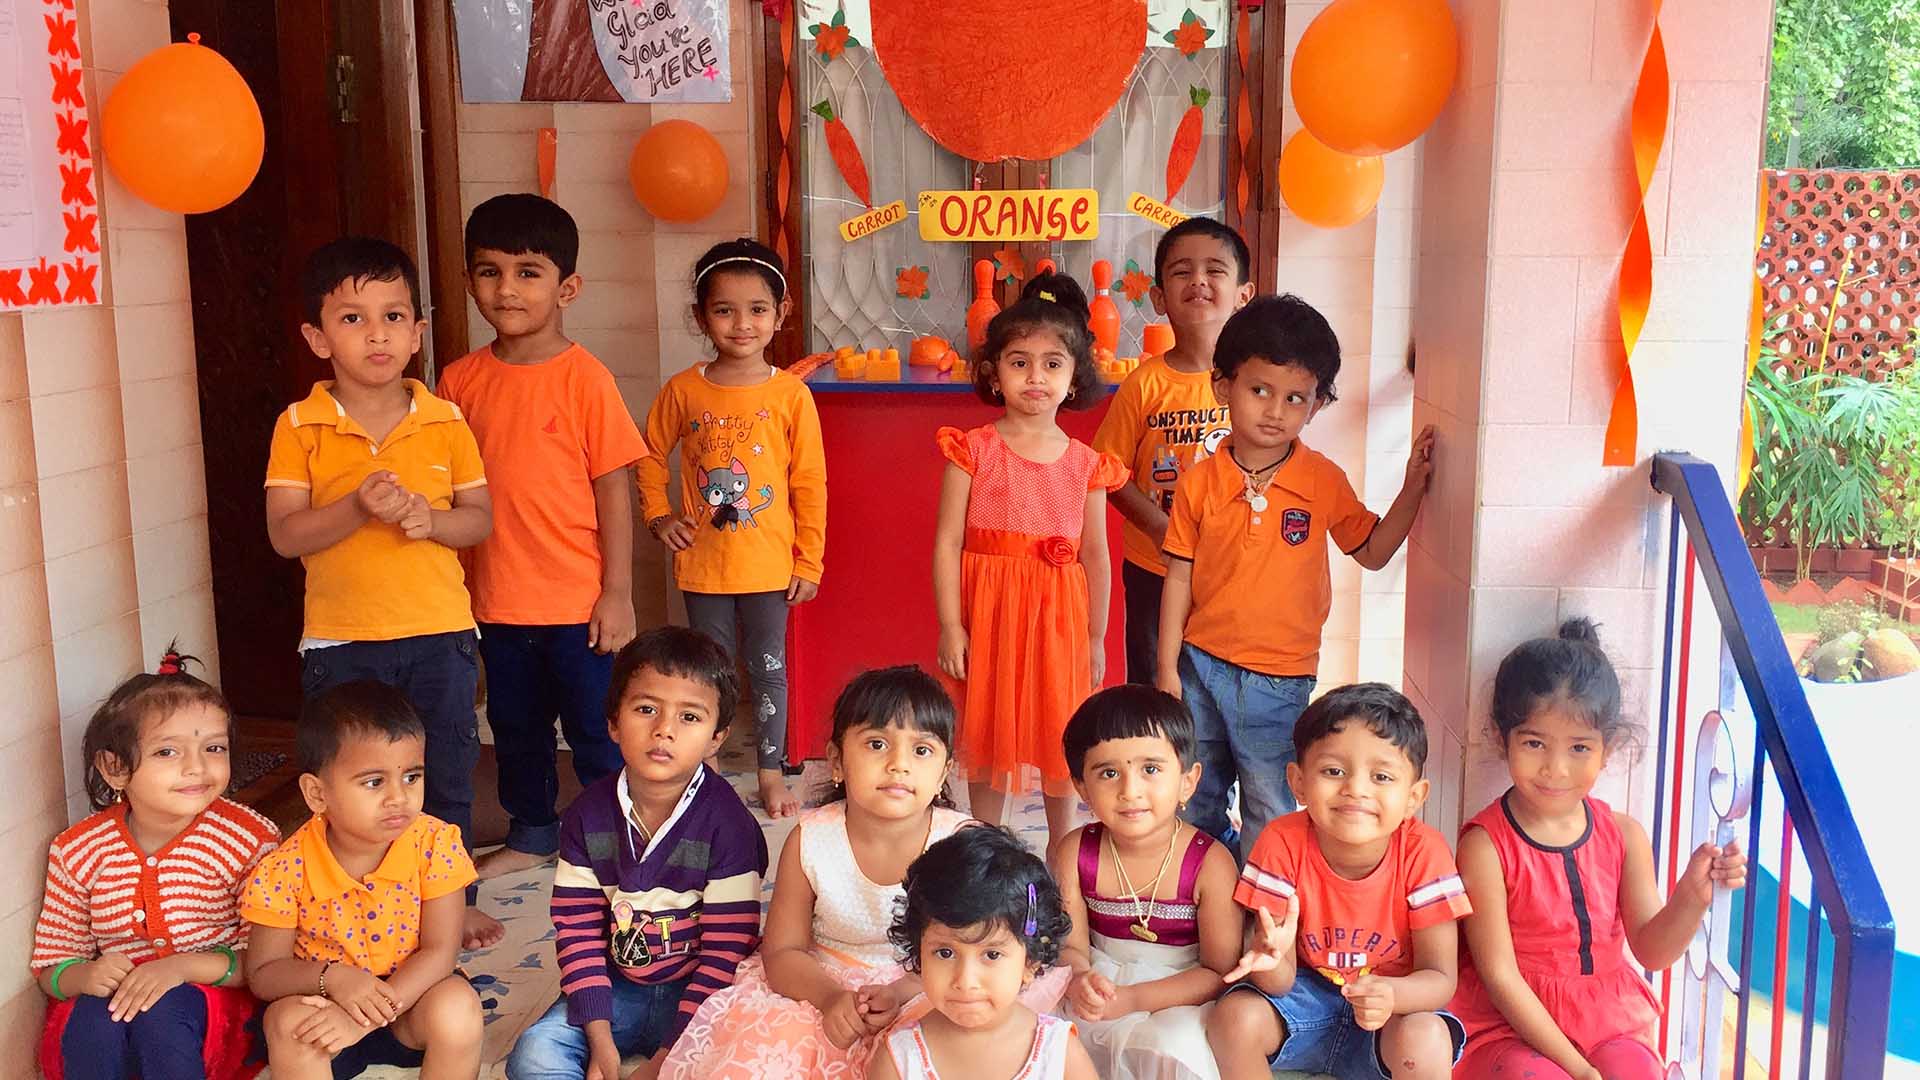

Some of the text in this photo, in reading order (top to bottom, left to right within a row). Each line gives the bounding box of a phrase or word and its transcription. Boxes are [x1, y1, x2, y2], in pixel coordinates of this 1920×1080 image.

[644, 37, 718, 97] HERE
[847, 203, 901, 238] CARROT
[1146, 407, 1229, 430] ONSTRUCT
[1163, 427, 1206, 444] TIME
[1303, 926, 1406, 960] ROPERT
[1336, 951, 1361, 968] OF
